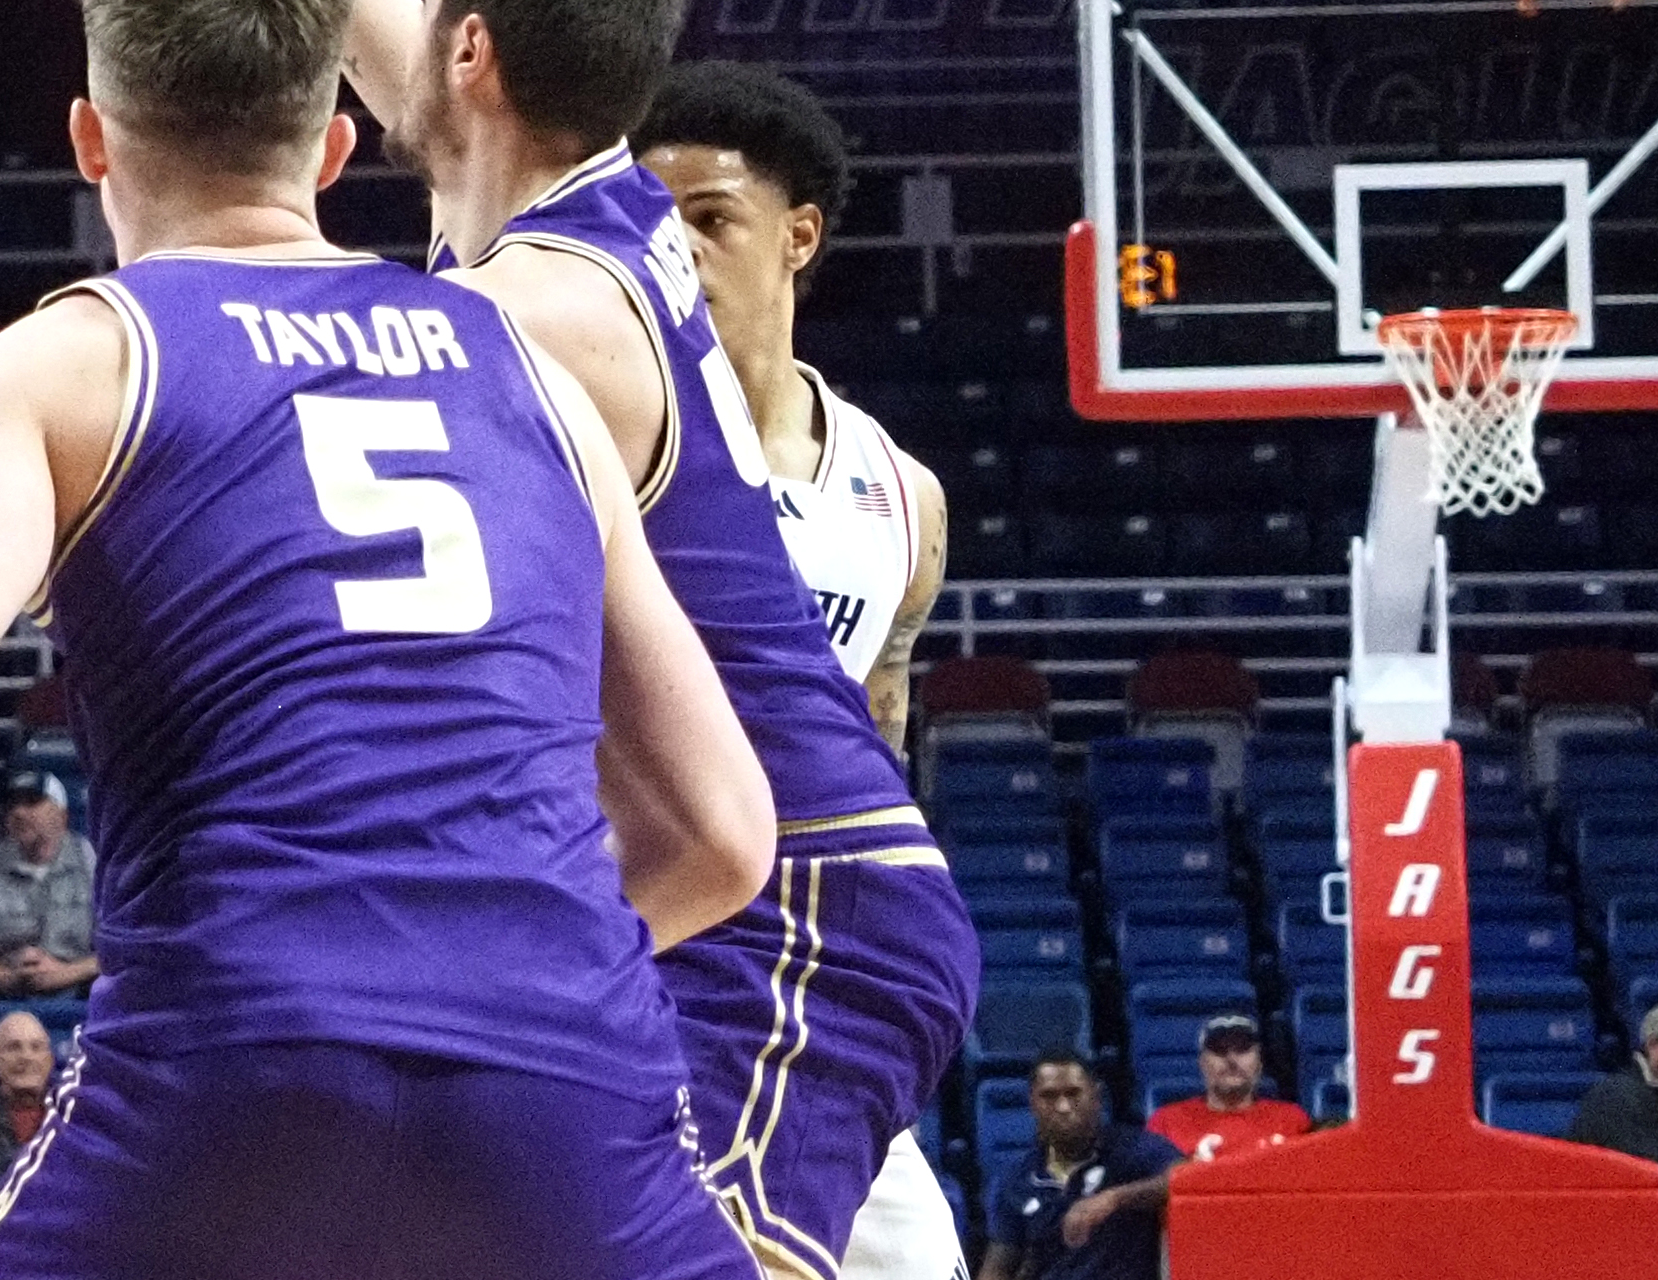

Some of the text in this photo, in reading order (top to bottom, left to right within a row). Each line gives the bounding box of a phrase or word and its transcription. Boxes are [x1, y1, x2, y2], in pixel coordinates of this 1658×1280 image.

[219, 301, 471, 377] TAYLOR
[292, 392, 493, 634] 5
[1383, 768, 1443, 1085] JAGS
